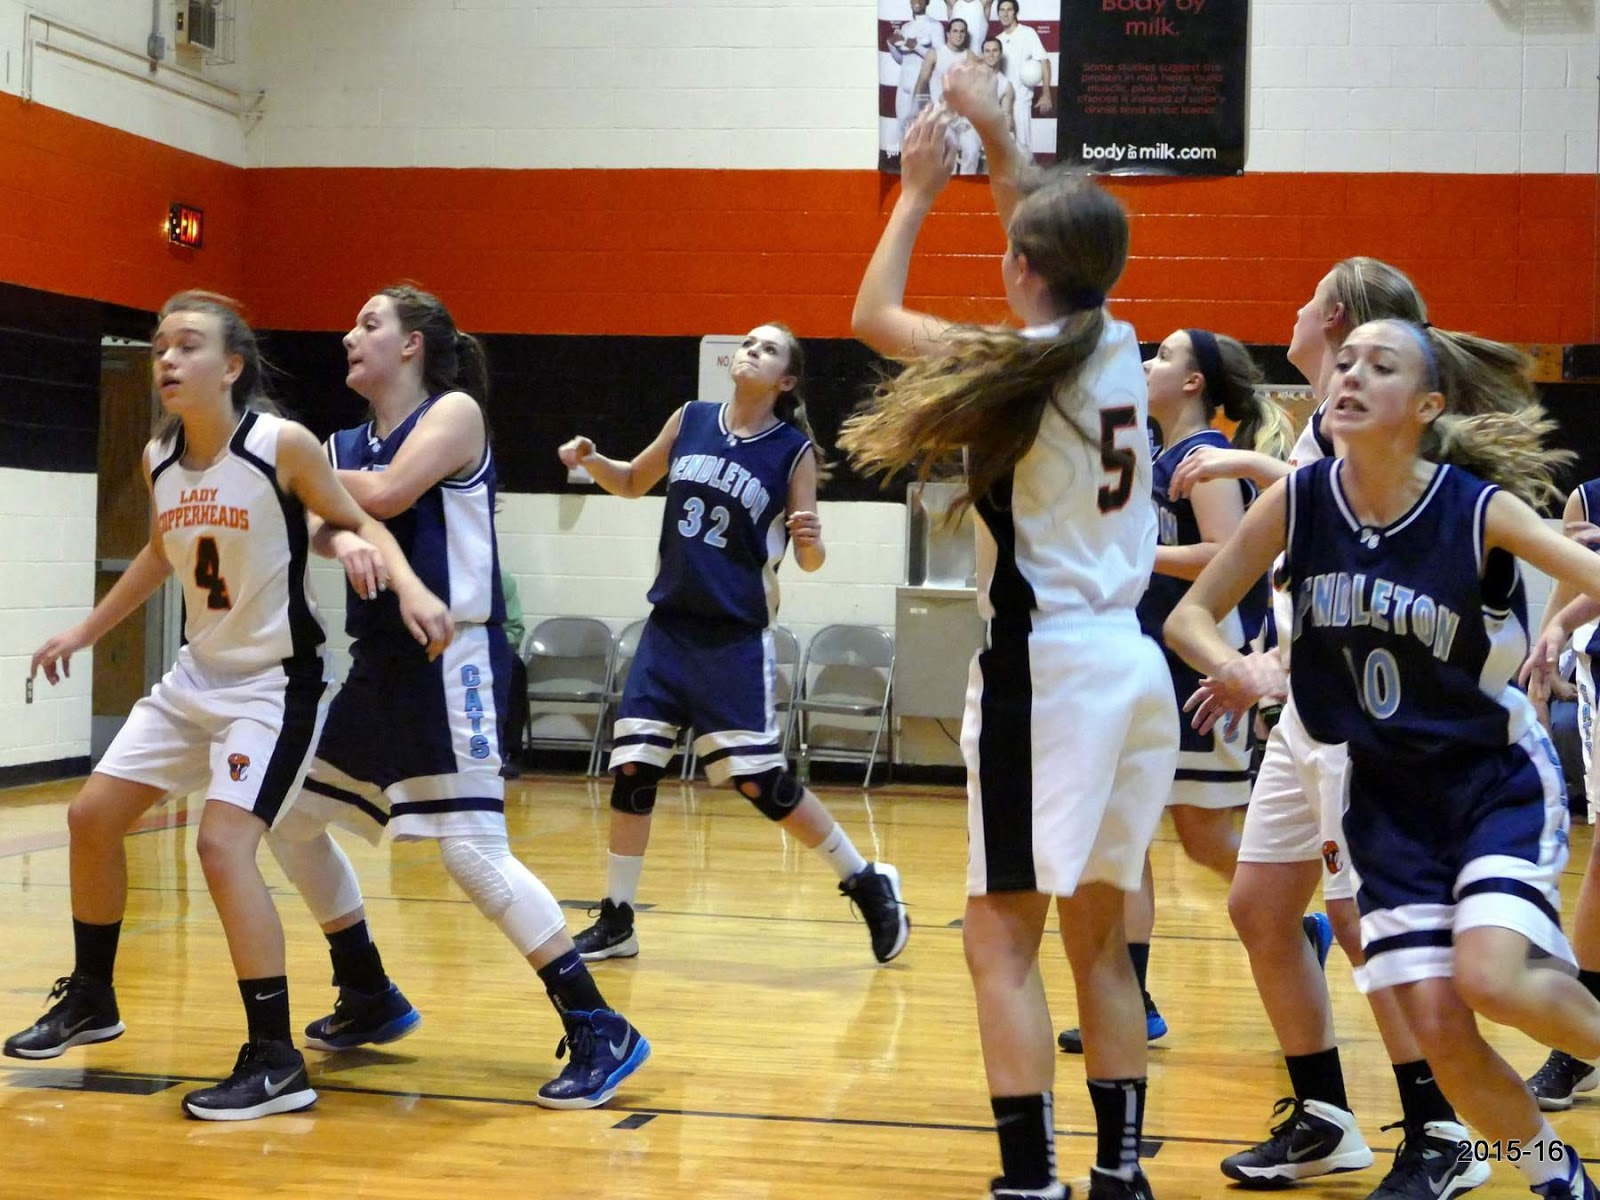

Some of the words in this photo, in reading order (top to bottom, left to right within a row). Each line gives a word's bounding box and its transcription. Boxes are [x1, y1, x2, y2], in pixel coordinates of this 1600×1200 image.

[1125, 17, 1180, 36] milk.
[717, 355, 730, 367] NO
[1097, 405, 1138, 516] 5
[180, 488, 219, 504] LADY
[678, 496, 731, 549] 32
[194, 535, 233, 612] 4
[460, 664, 491, 760] CATS
